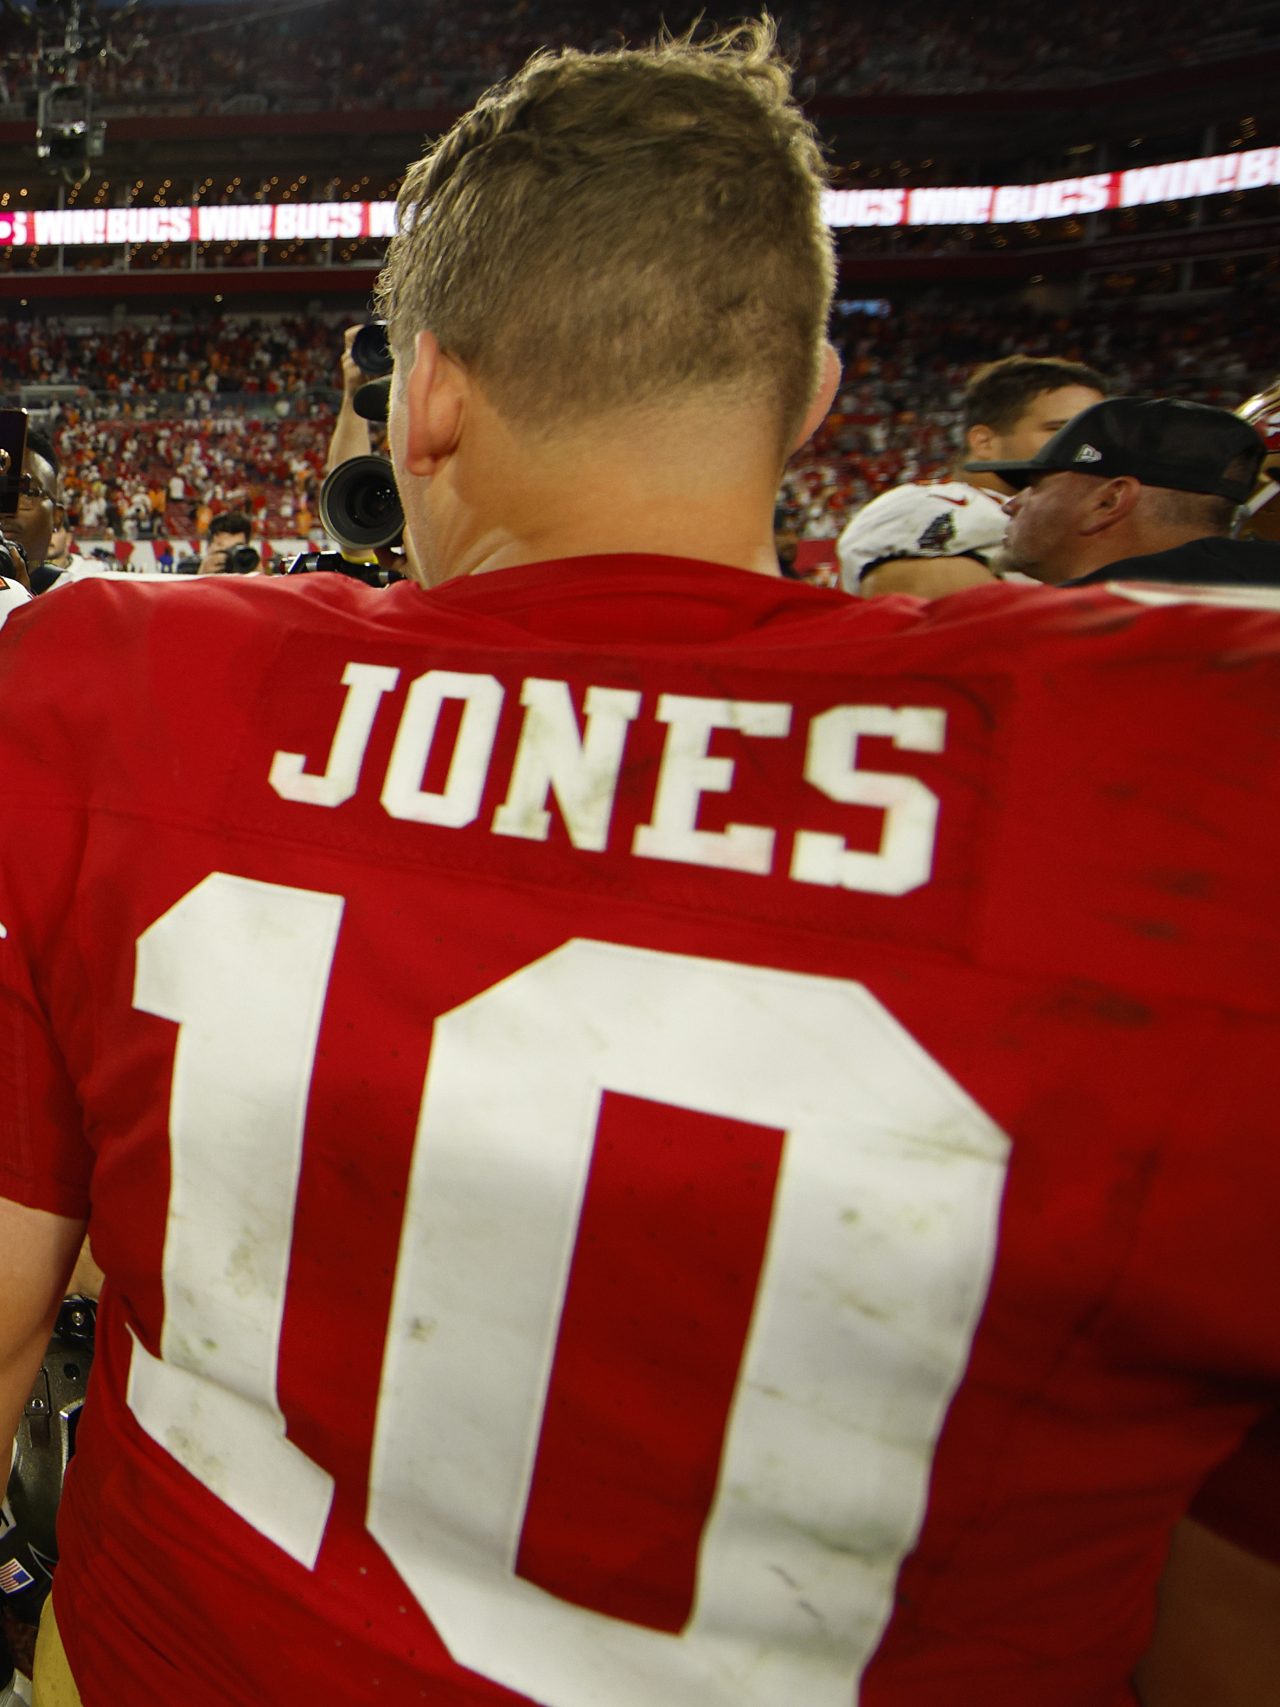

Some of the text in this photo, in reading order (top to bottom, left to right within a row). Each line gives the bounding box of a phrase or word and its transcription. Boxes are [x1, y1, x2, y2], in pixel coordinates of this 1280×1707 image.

[34, 211, 105, 243] WIN!
[107, 209, 190, 242] BUCS
[199, 206, 272, 240] WIN!
[276, 204, 361, 239] BUCS
[910, 188, 993, 224] WIN!
[995, 175, 1109, 222] BUCS
[1122, 154, 1238, 207] WIN!
[268, 661, 947, 896] JONES
[125, 871, 1013, 1707] 10
